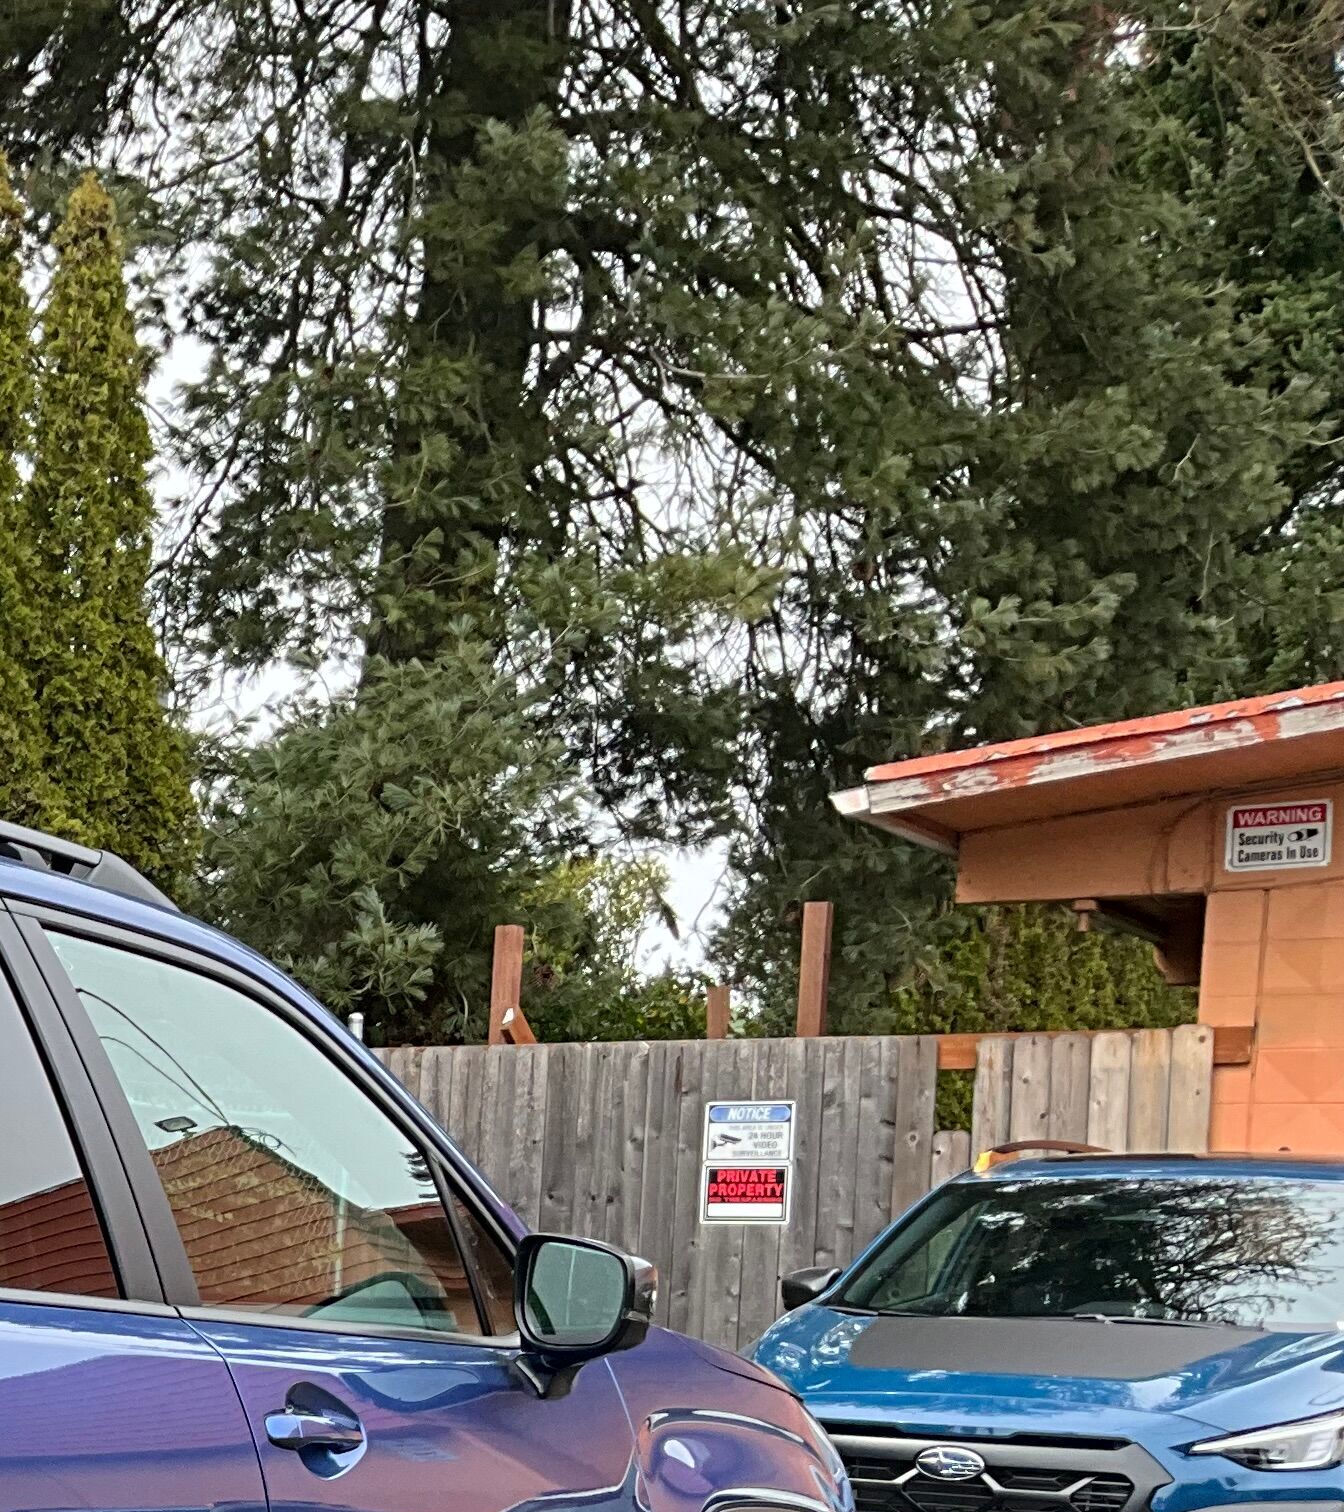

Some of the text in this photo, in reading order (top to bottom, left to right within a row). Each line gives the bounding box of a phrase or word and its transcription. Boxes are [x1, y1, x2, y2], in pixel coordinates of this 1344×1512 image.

[1238, 807, 1322, 826] WARNING
[1238, 831, 1284, 846] Security
[1238, 845, 1318, 862] Cameras In Use
[727, 1107, 771, 1120] NOTICE
[753, 1141, 778, 1149] VIDEO
[717, 1170, 777, 1183] PRIVATE
[709, 1183, 783, 1197] PROPERTY
